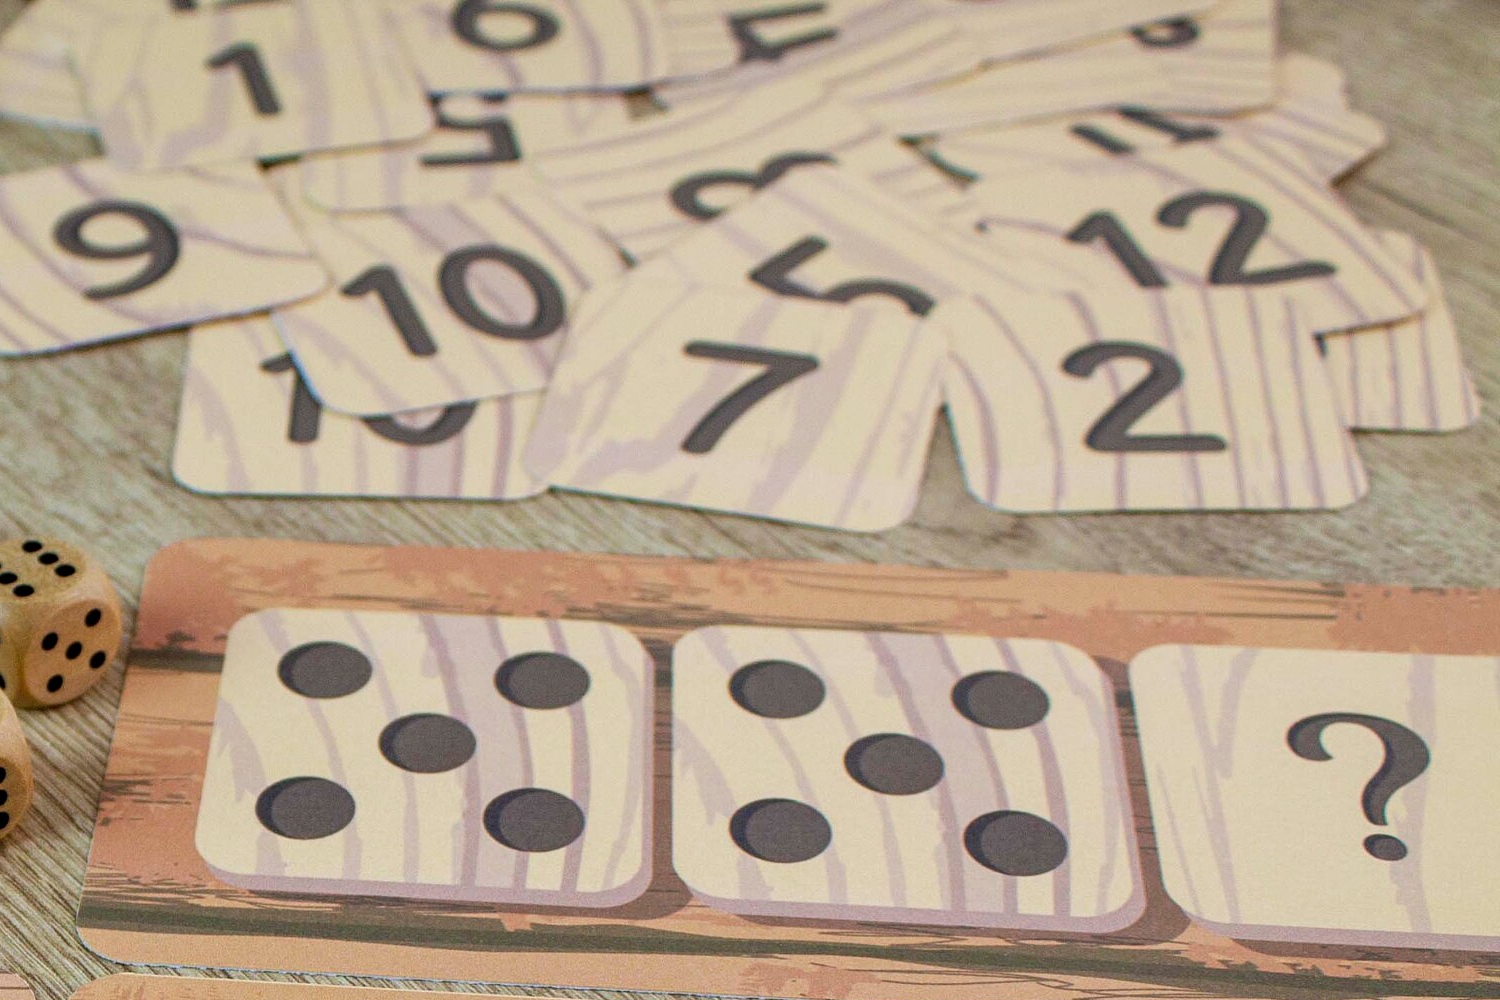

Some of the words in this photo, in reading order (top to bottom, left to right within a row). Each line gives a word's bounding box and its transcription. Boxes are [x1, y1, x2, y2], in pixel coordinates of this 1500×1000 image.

[206, 41, 281, 117] 1
[53, 200, 181, 300] 9
[1066, 190, 1338, 288] 12
[342, 244, 566, 358] 10
[681, 340, 821, 454] 7
[1061, 340, 1228, 453] 2
[1285, 711, 1431, 862] ?
